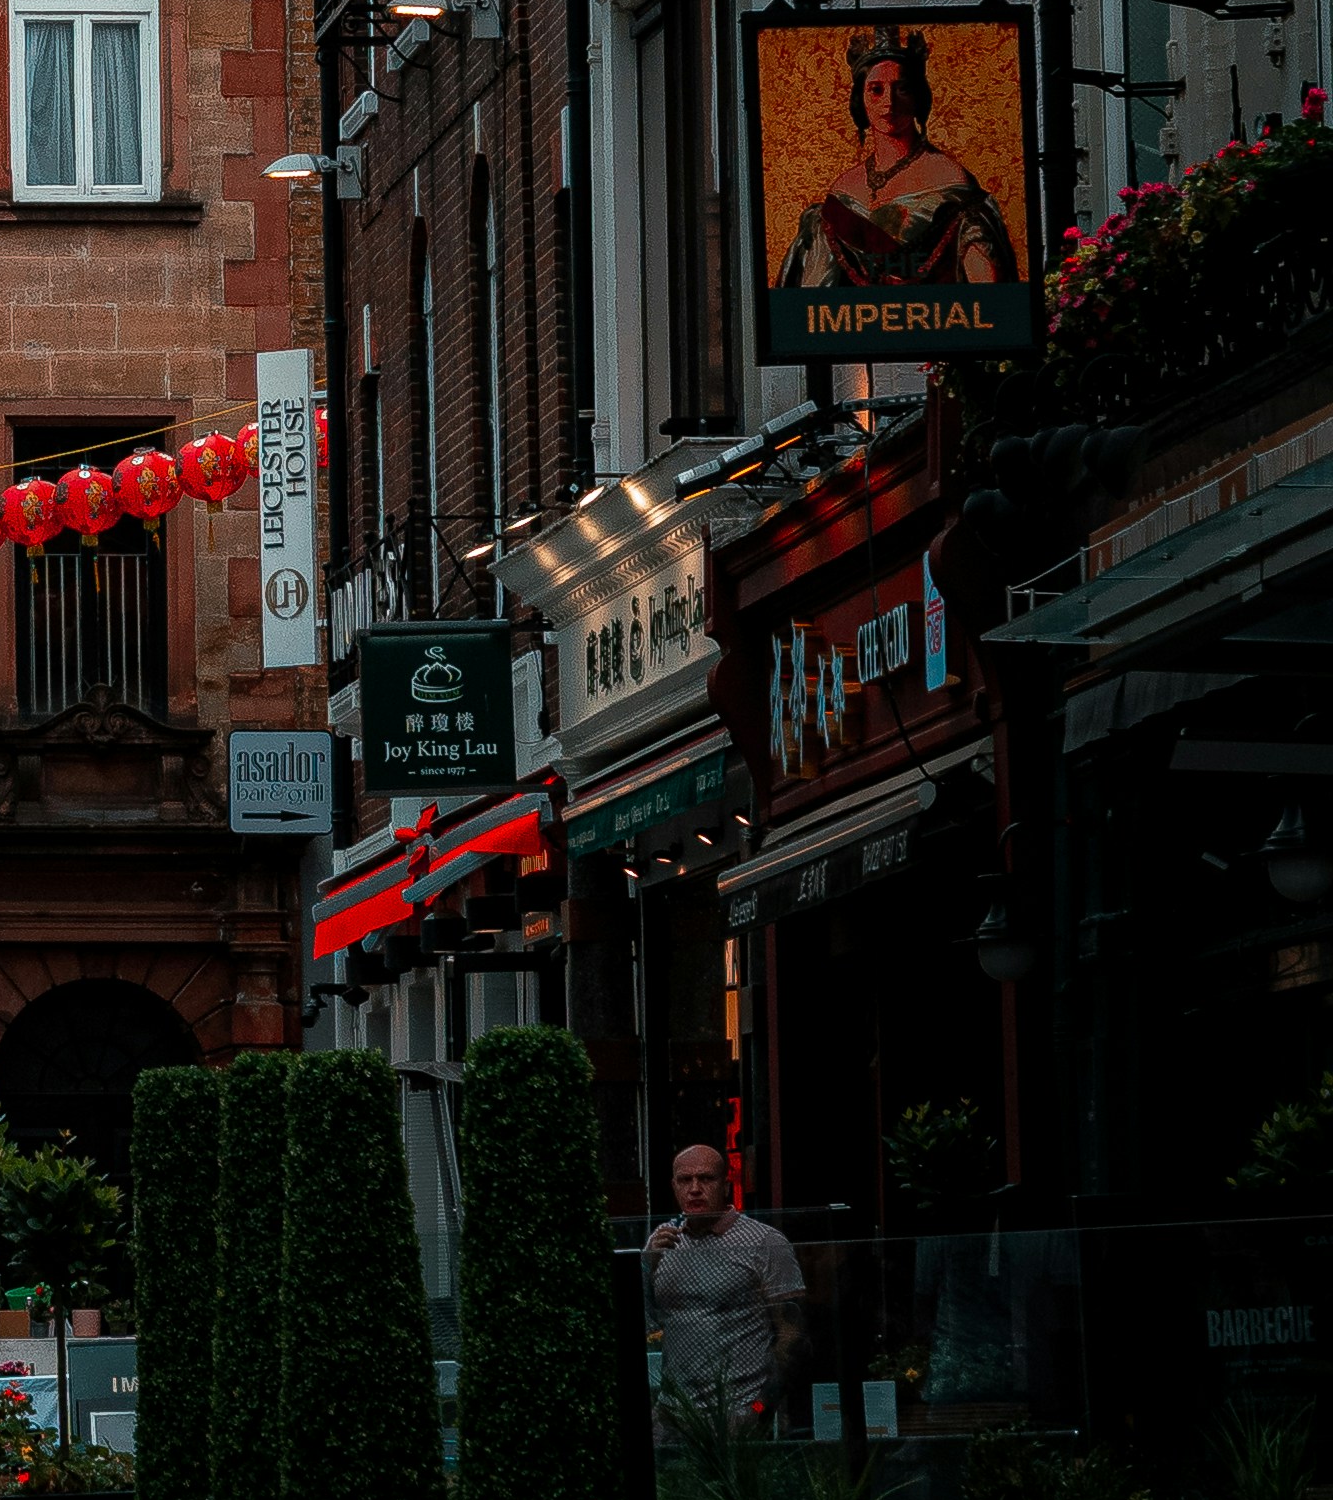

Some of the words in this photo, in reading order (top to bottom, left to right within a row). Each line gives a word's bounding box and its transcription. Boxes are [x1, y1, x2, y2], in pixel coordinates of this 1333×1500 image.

[806, 301, 994, 333] IMPERIAL
[285, 396, 308, 497] HOUSE
[261, 398, 285, 549] LEICESTER
[236, 741, 326, 783] asador
[384, 741, 412, 763] Joy
[417, 740, 460, 761] King
[464, 738, 498, 756] Lau
[420, 766, 446, 776] since
[447, 766, 466, 777] 1977
[1206, 1304, 1317, 1348] BARBECUE
